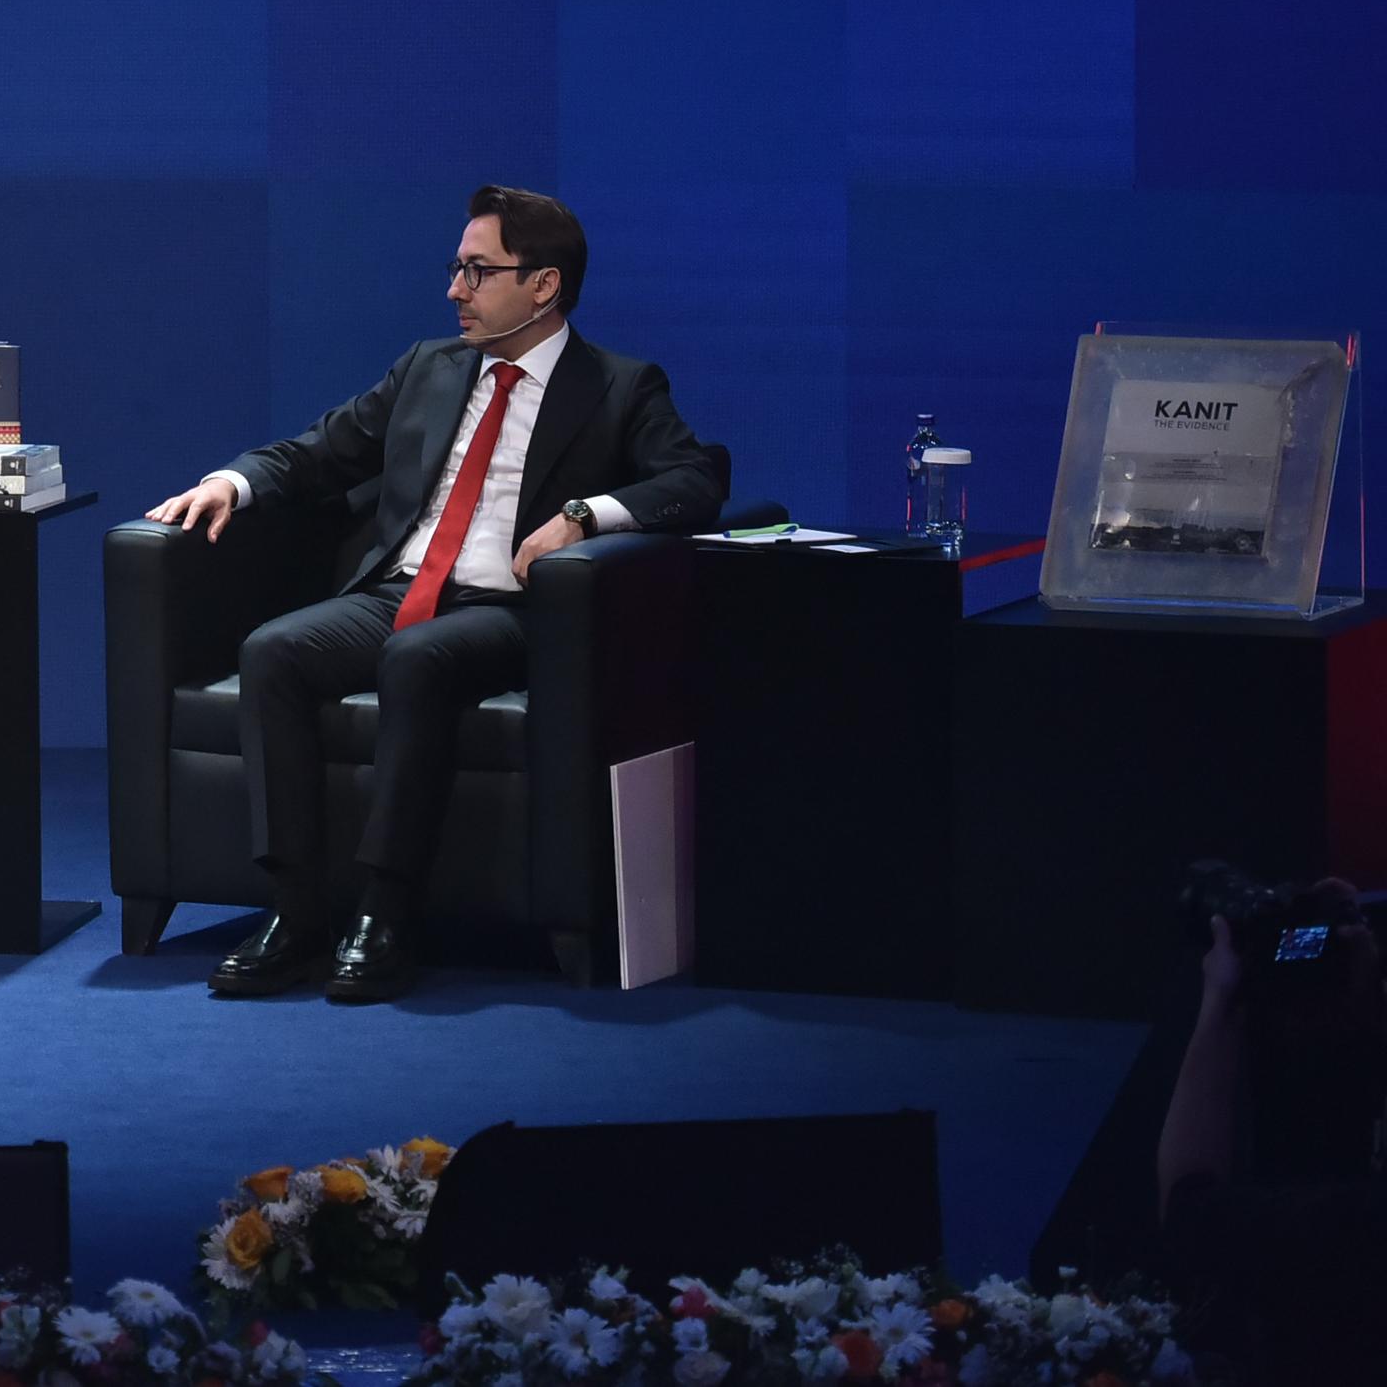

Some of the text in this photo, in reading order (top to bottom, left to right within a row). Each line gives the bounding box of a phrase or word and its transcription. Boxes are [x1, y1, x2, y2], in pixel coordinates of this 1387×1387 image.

[1155, 400, 1238, 420] KANIT
[1155, 420, 1230, 431] THE EVIDENCE
